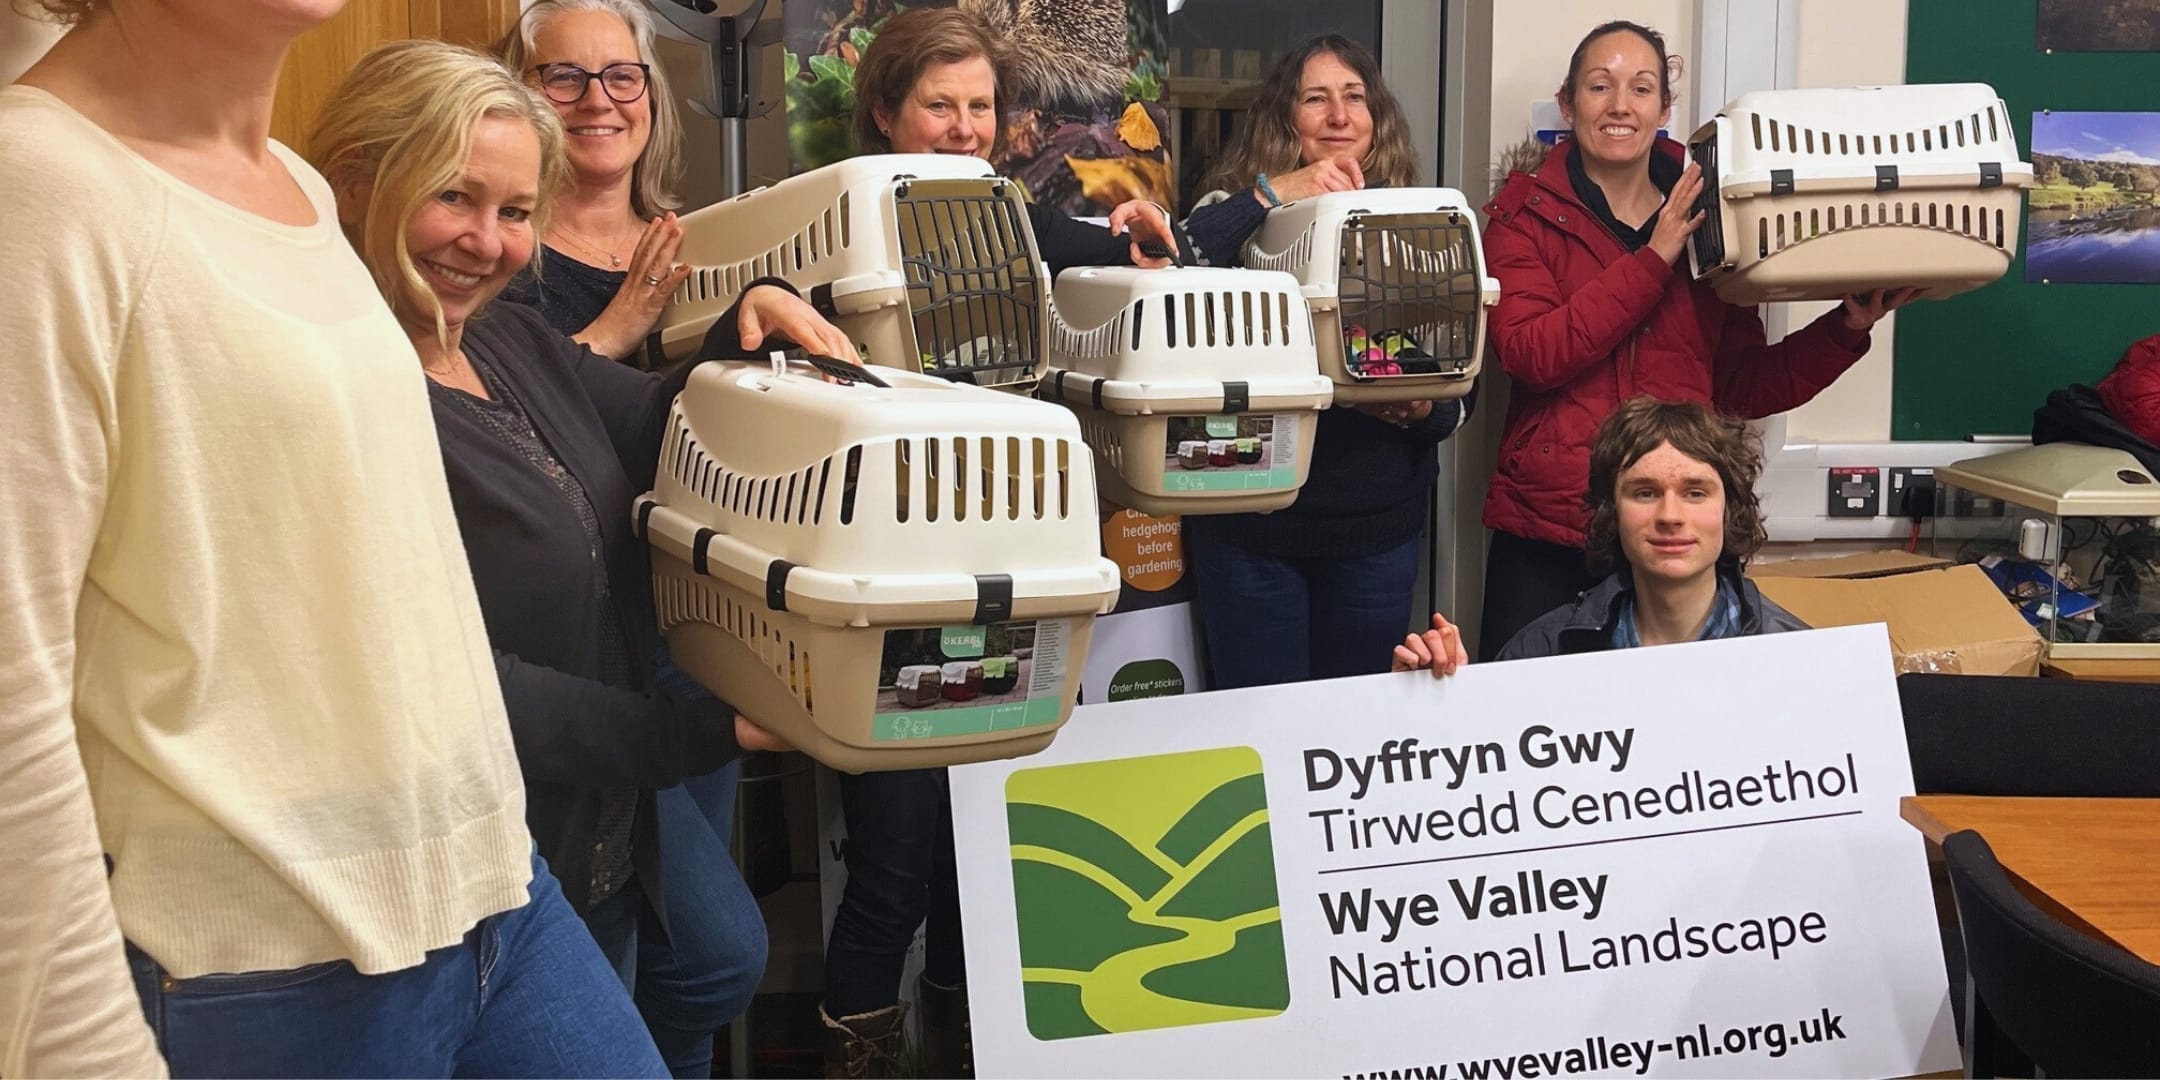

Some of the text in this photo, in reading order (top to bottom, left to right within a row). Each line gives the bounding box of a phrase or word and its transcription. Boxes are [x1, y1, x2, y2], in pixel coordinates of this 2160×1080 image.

[1128, 558, 1182, 578] gardening
[1137, 541, 1173, 555] before
[1110, 683, 1133, 694] Order
[1154, 678, 1182, 689] stickers
[1303, 725, 1635, 801] Dyffryn Gwy
[1308, 753, 1859, 853] Tirwedd Cenedlaethol
[1318, 869, 1609, 943] Wye Valley
[1329, 911, 1828, 999] National Landscape
[1343, 1007, 1847, 1080] wwyevalley-nl.org.uk
